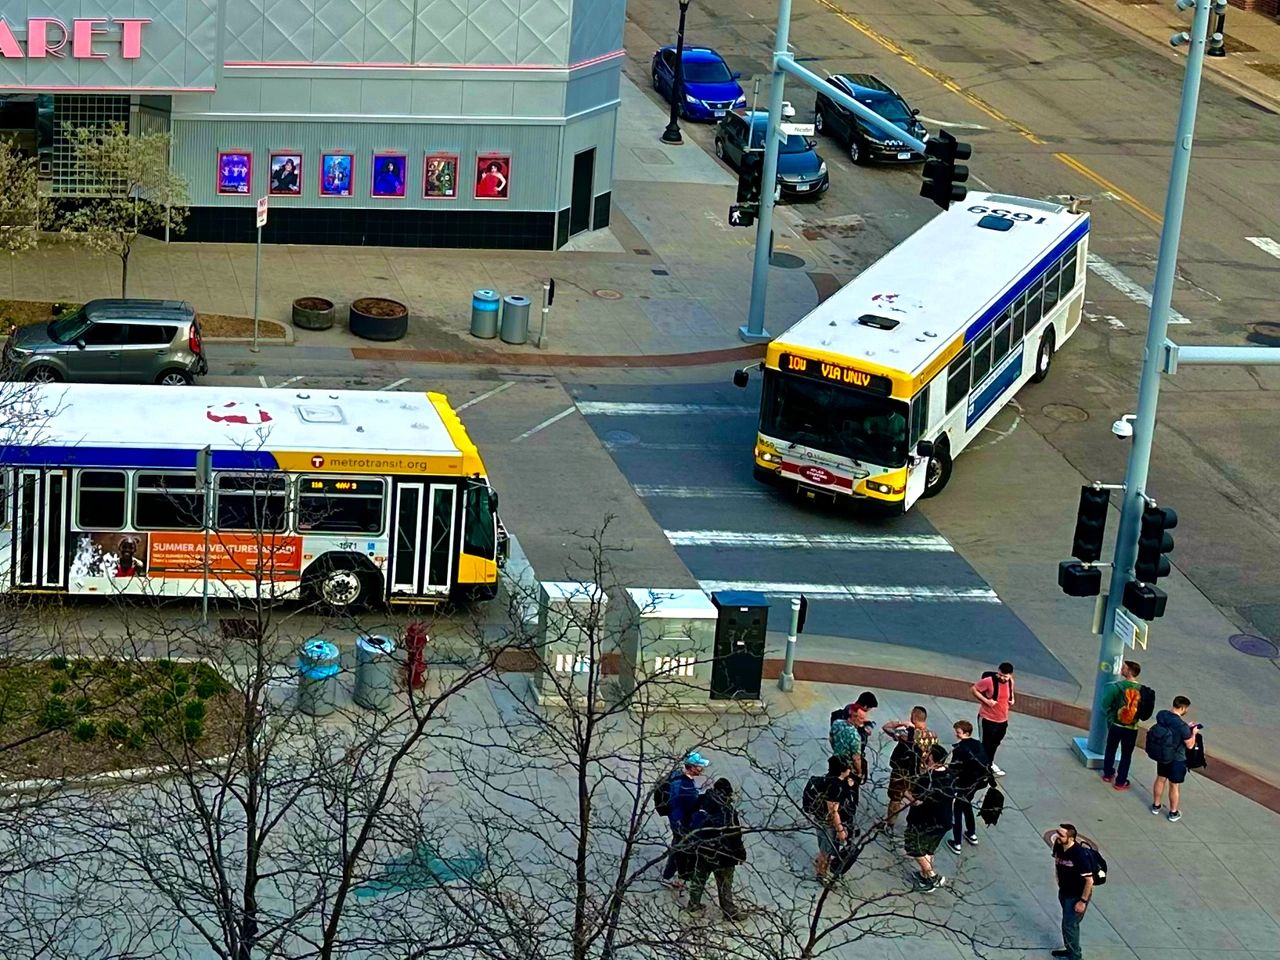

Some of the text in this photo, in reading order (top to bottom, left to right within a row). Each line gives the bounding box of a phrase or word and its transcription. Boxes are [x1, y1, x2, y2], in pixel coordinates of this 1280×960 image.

[821, 362, 841, 380] VIA
[843, 369, 871, 387] UNIV
[330, 457, 428, 472] metrotransit.org
[153, 542, 194, 552] SUMMER
